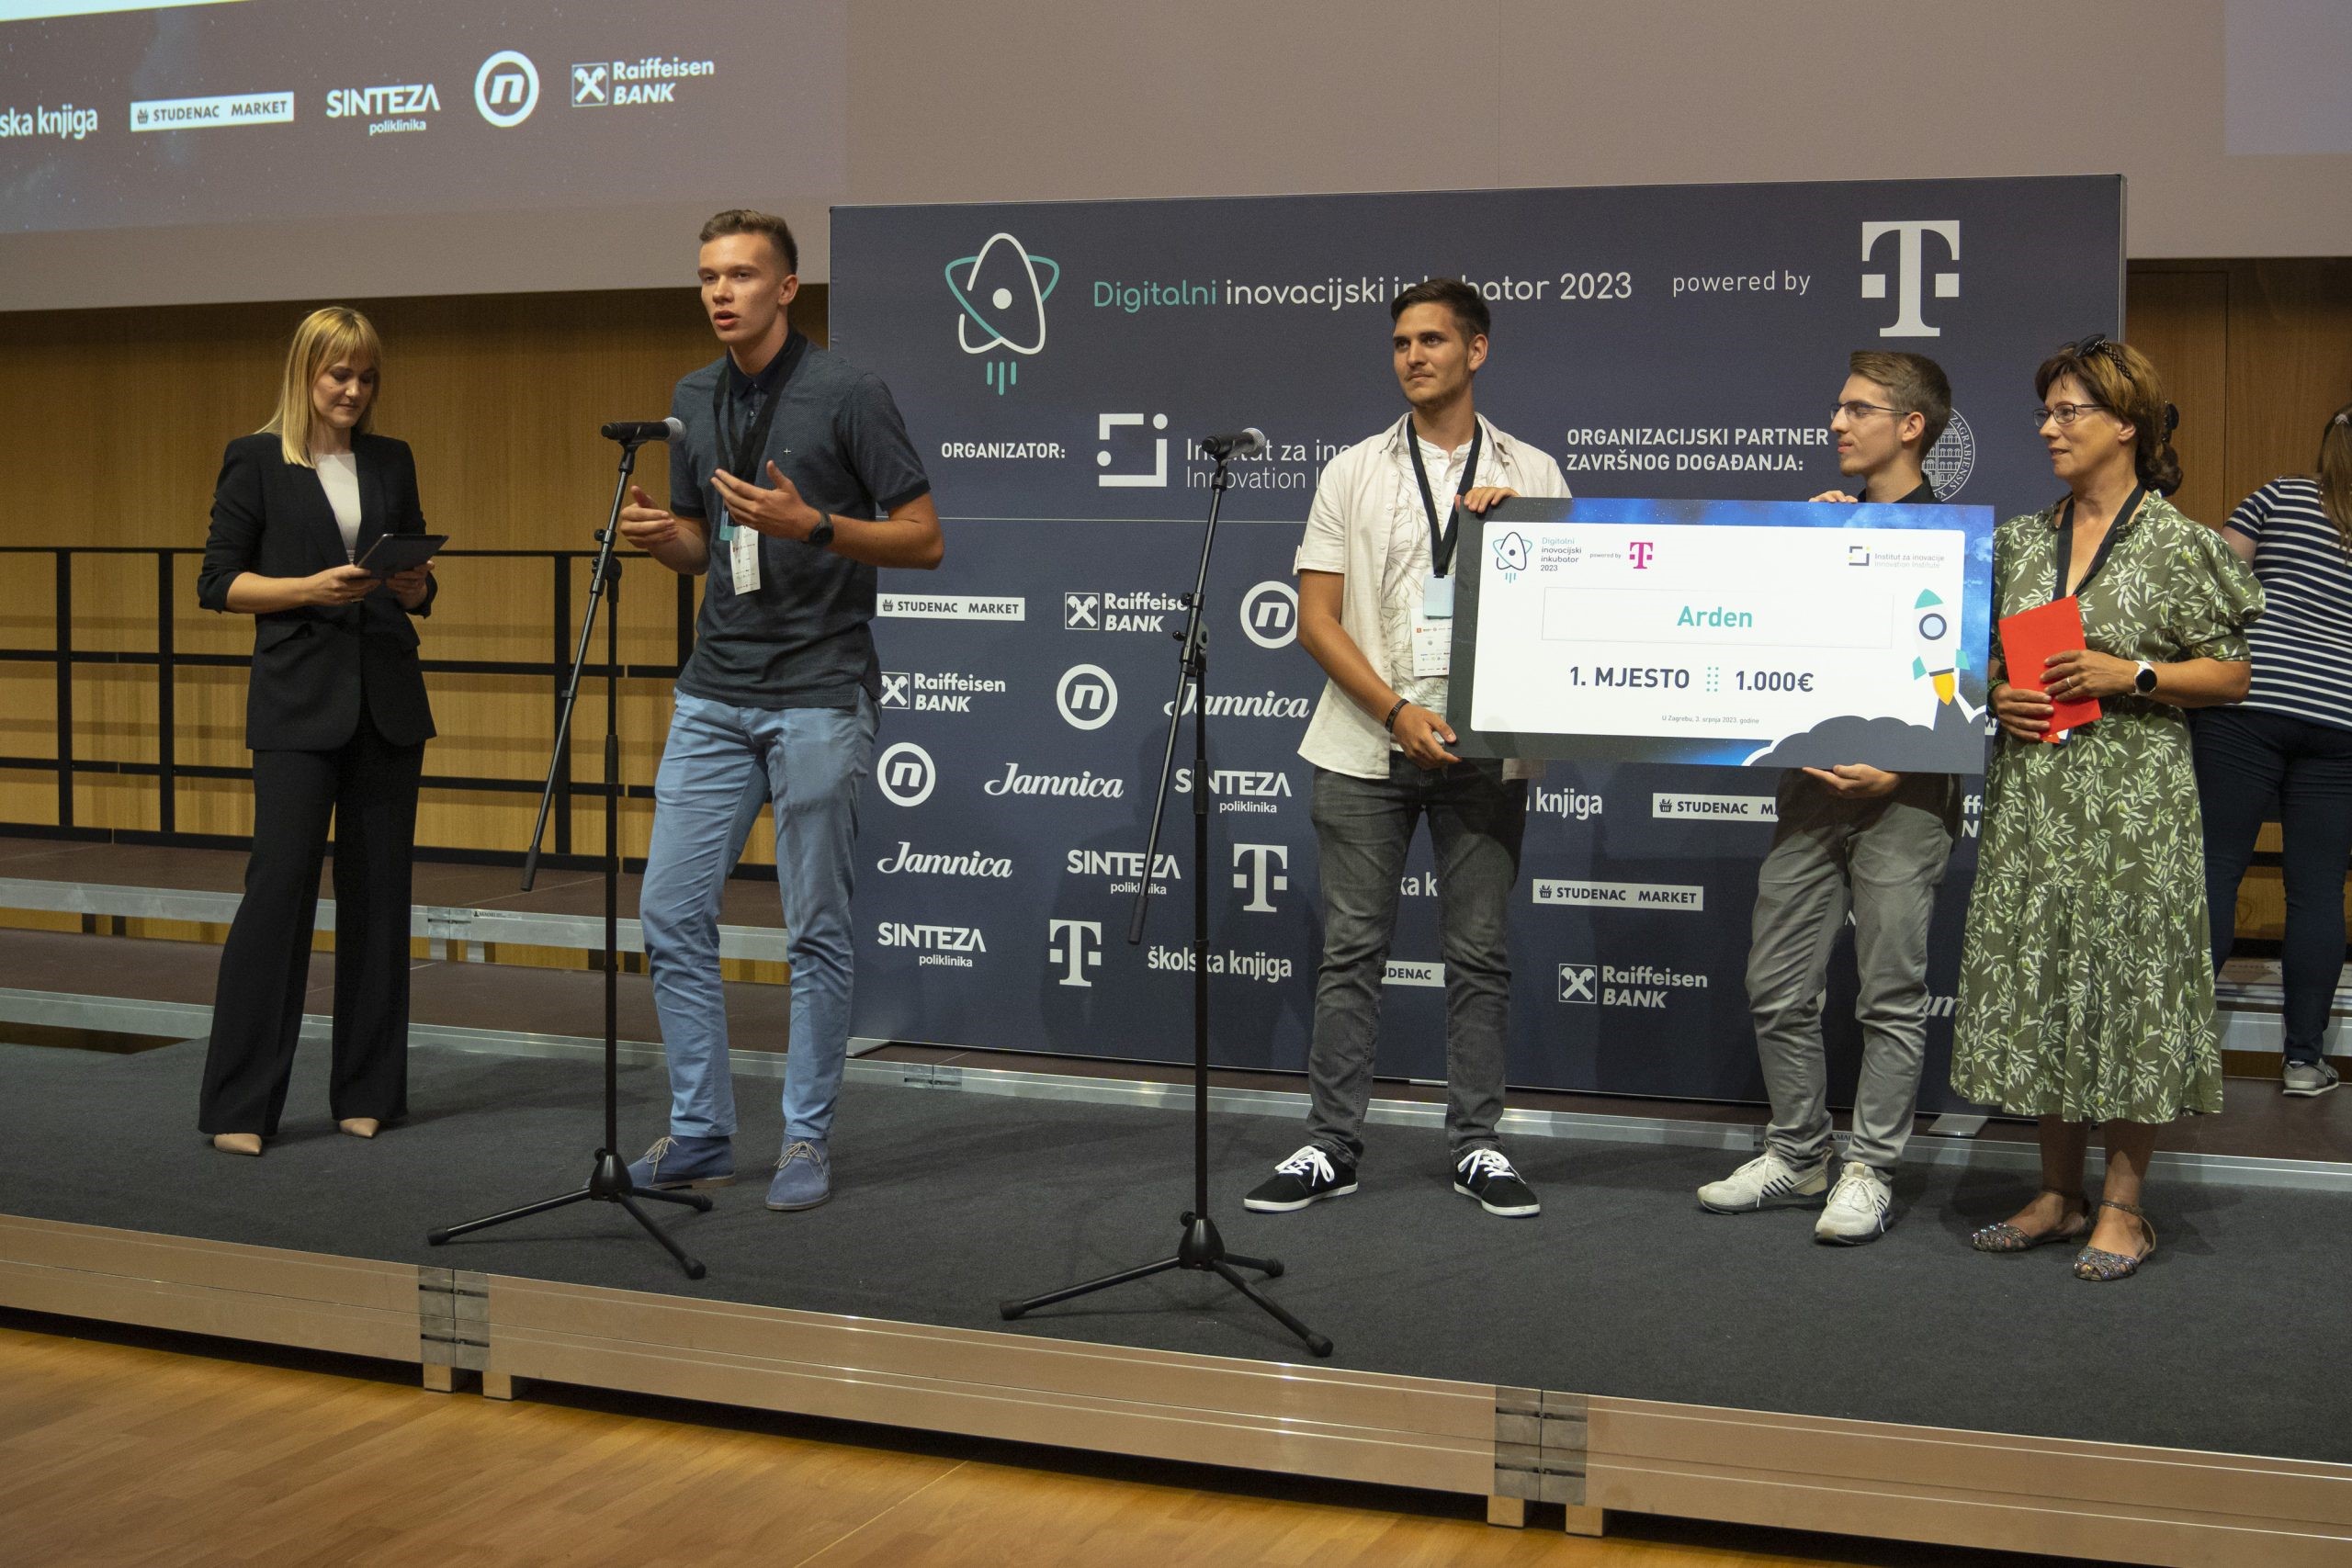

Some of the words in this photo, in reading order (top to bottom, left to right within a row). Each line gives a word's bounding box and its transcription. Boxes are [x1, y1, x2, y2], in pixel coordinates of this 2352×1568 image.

[613, 56, 715, 81] Raiffeisen
[325, 84, 441, 118] SINTEZA
[613, 82, 676, 106] BANK
[37, 102, 98, 141] knjiga
[153, 105, 220, 122] STUDENAC
[231, 100, 288, 117] MARKET
[368, 118, 427, 137] poliklinika
[1673, 270, 1775, 298] powered
[1784, 269, 1811, 296] by
[1861, 220, 1960, 338] T
[1093, 279, 1216, 313] Digitalni
[1226, 276, 1385, 311] inovacijski
[1560, 271, 1633, 300] 2023
[1566, 428, 1728, 446] ORGANIZACIJSKI
[1735, 428, 1829, 446] PARTNER
[941, 442, 1066, 459] ORGANIZATOR:
[1281, 445, 1306, 462] za
[1566, 448, 1670, 471] ZAVRŠNOG
[1676, 454, 1804, 471] DOGAĐANJA:
[1541, 546, 1583, 557] inovacijski
[1542, 536, 1576, 547] Digitalni
[1540, 555, 1579, 564] inkubator
[1629, 541, 1654, 570] T
[1540, 563, 1559, 572] 2023
[898, 601, 958, 614] STUDENAC
[967, 603, 1020, 615] MARKET
[1255, 603, 1291, 628] n
[1677, 605, 1753, 628] Arden
[1104, 614, 1165, 633] BANK
[914, 672, 1006, 693] Raiffeisen
[1570, 666, 1587, 686] 1.
[1594, 666, 1690, 689] MJESTO
[1736, 670, 1815, 693] 1.000€
[914, 694, 972, 713] BANK
[1070, 684, 1104, 710] n
[891, 762, 923, 789] n
[983, 762, 1125, 798] Jamnica
[1174, 768, 1293, 797] SNTEZA
[1219, 800, 1278, 814] poliklinika
[1535, 786, 1603, 821] knjiga
[1677, 800, 1748, 815] STUDENAC
[876, 840, 1013, 878] Jamnica
[1065, 847, 1183, 880] SINTEZA
[1232, 842, 1289, 914] T
[1556, 886, 1627, 901] STUDENAC
[1637, 890, 1697, 904] MARKET
[877, 921, 987, 953] SINTEZA
[919, 953, 973, 967] poliklinika
[1048, 919, 1102, 987] T
[1229, 949, 1292, 984] knjiga
[1602, 965, 1708, 988] Raiffeisen
[1602, 987, 1668, 1009] BANK
